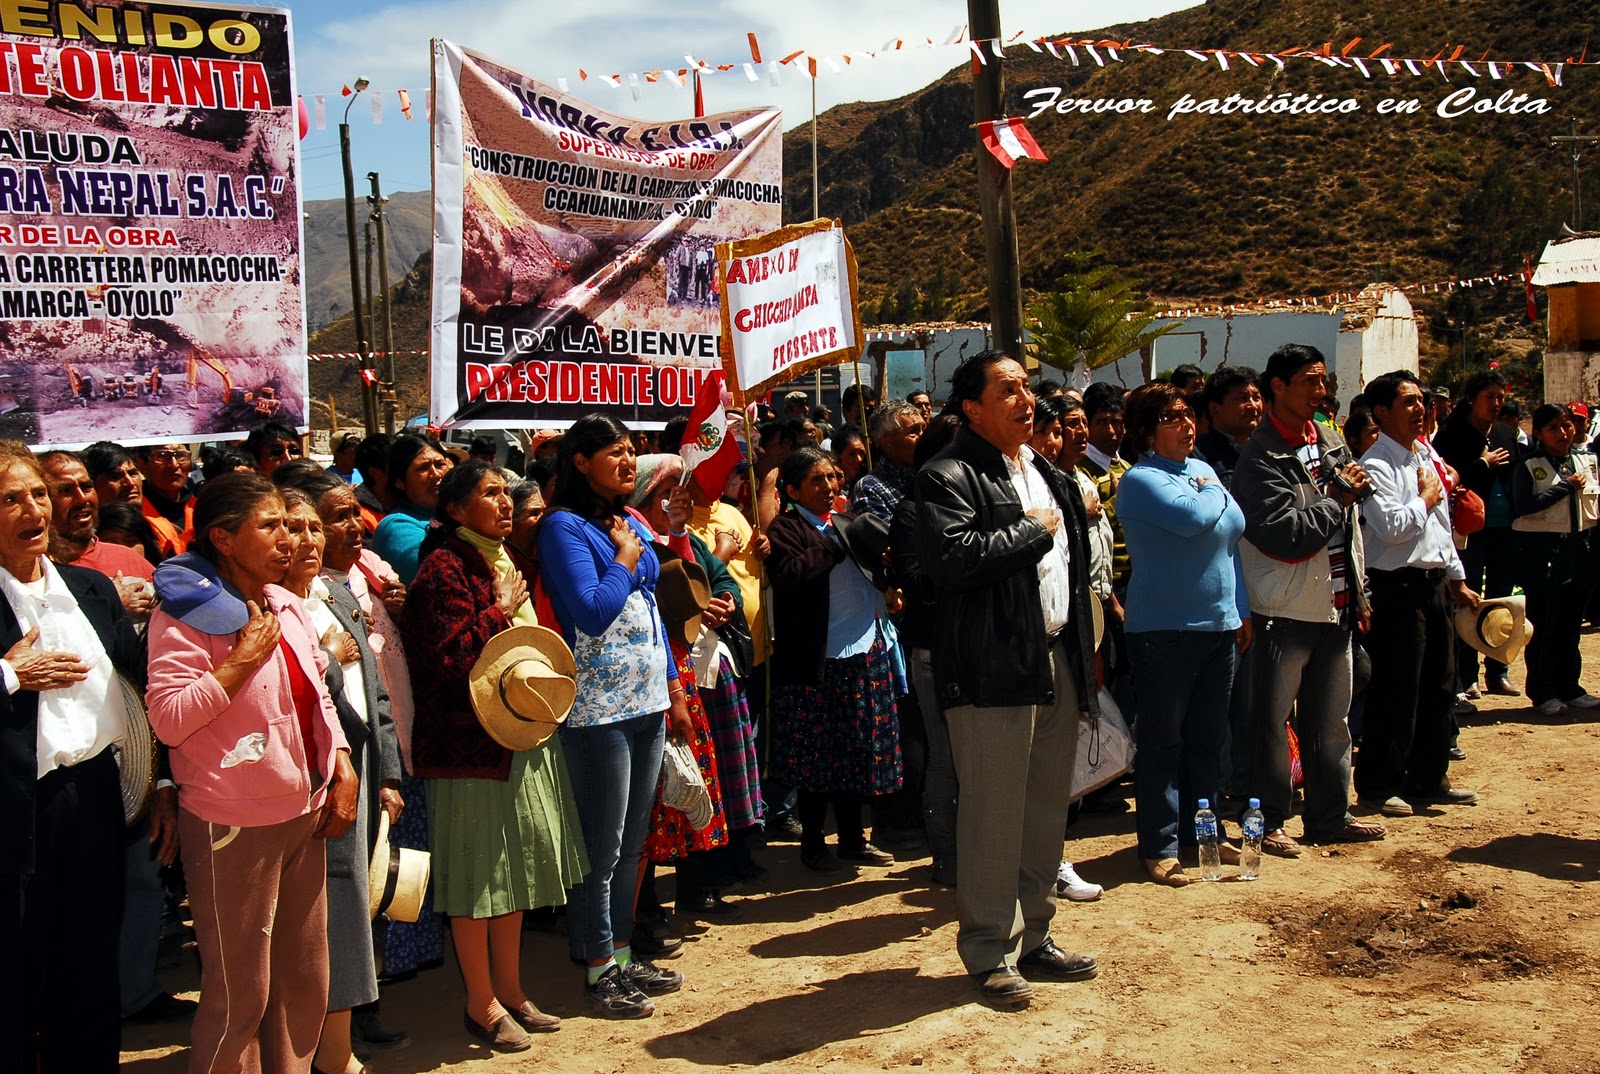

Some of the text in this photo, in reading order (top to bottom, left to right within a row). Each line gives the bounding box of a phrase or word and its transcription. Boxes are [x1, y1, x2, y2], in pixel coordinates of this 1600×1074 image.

[0, 0, 261, 54] ENIDO
[59, 46, 273, 111] OLLANTA
[510, 84, 637, 151] NORKA
[559, 131, 720, 171] SUPERVISOR DE OBRA
[58, 169, 180, 216] NEPAL
[601, 169, 619, 193] DE
[620, 174, 637, 195] LA
[639, 175, 701, 199] CARRETERA
[543, 186, 664, 221] CCAHUANAMARCA
[22, 226, 58, 245] DE
[67, 227, 101, 246] LA
[109, 227, 178, 247] OBRA
[15, 255, 147, 284] CARRETERA
[152, 255, 286, 283] POMACOCHA-
[726, 252, 785, 285] ANEXO
[0, 290, 89, 318] MARCA
[464, 323, 721, 358] LE DA LA BIENVE
[772, 326, 838, 371] PRESENTE
[466, 360, 654, 405] PRESIDENTE
